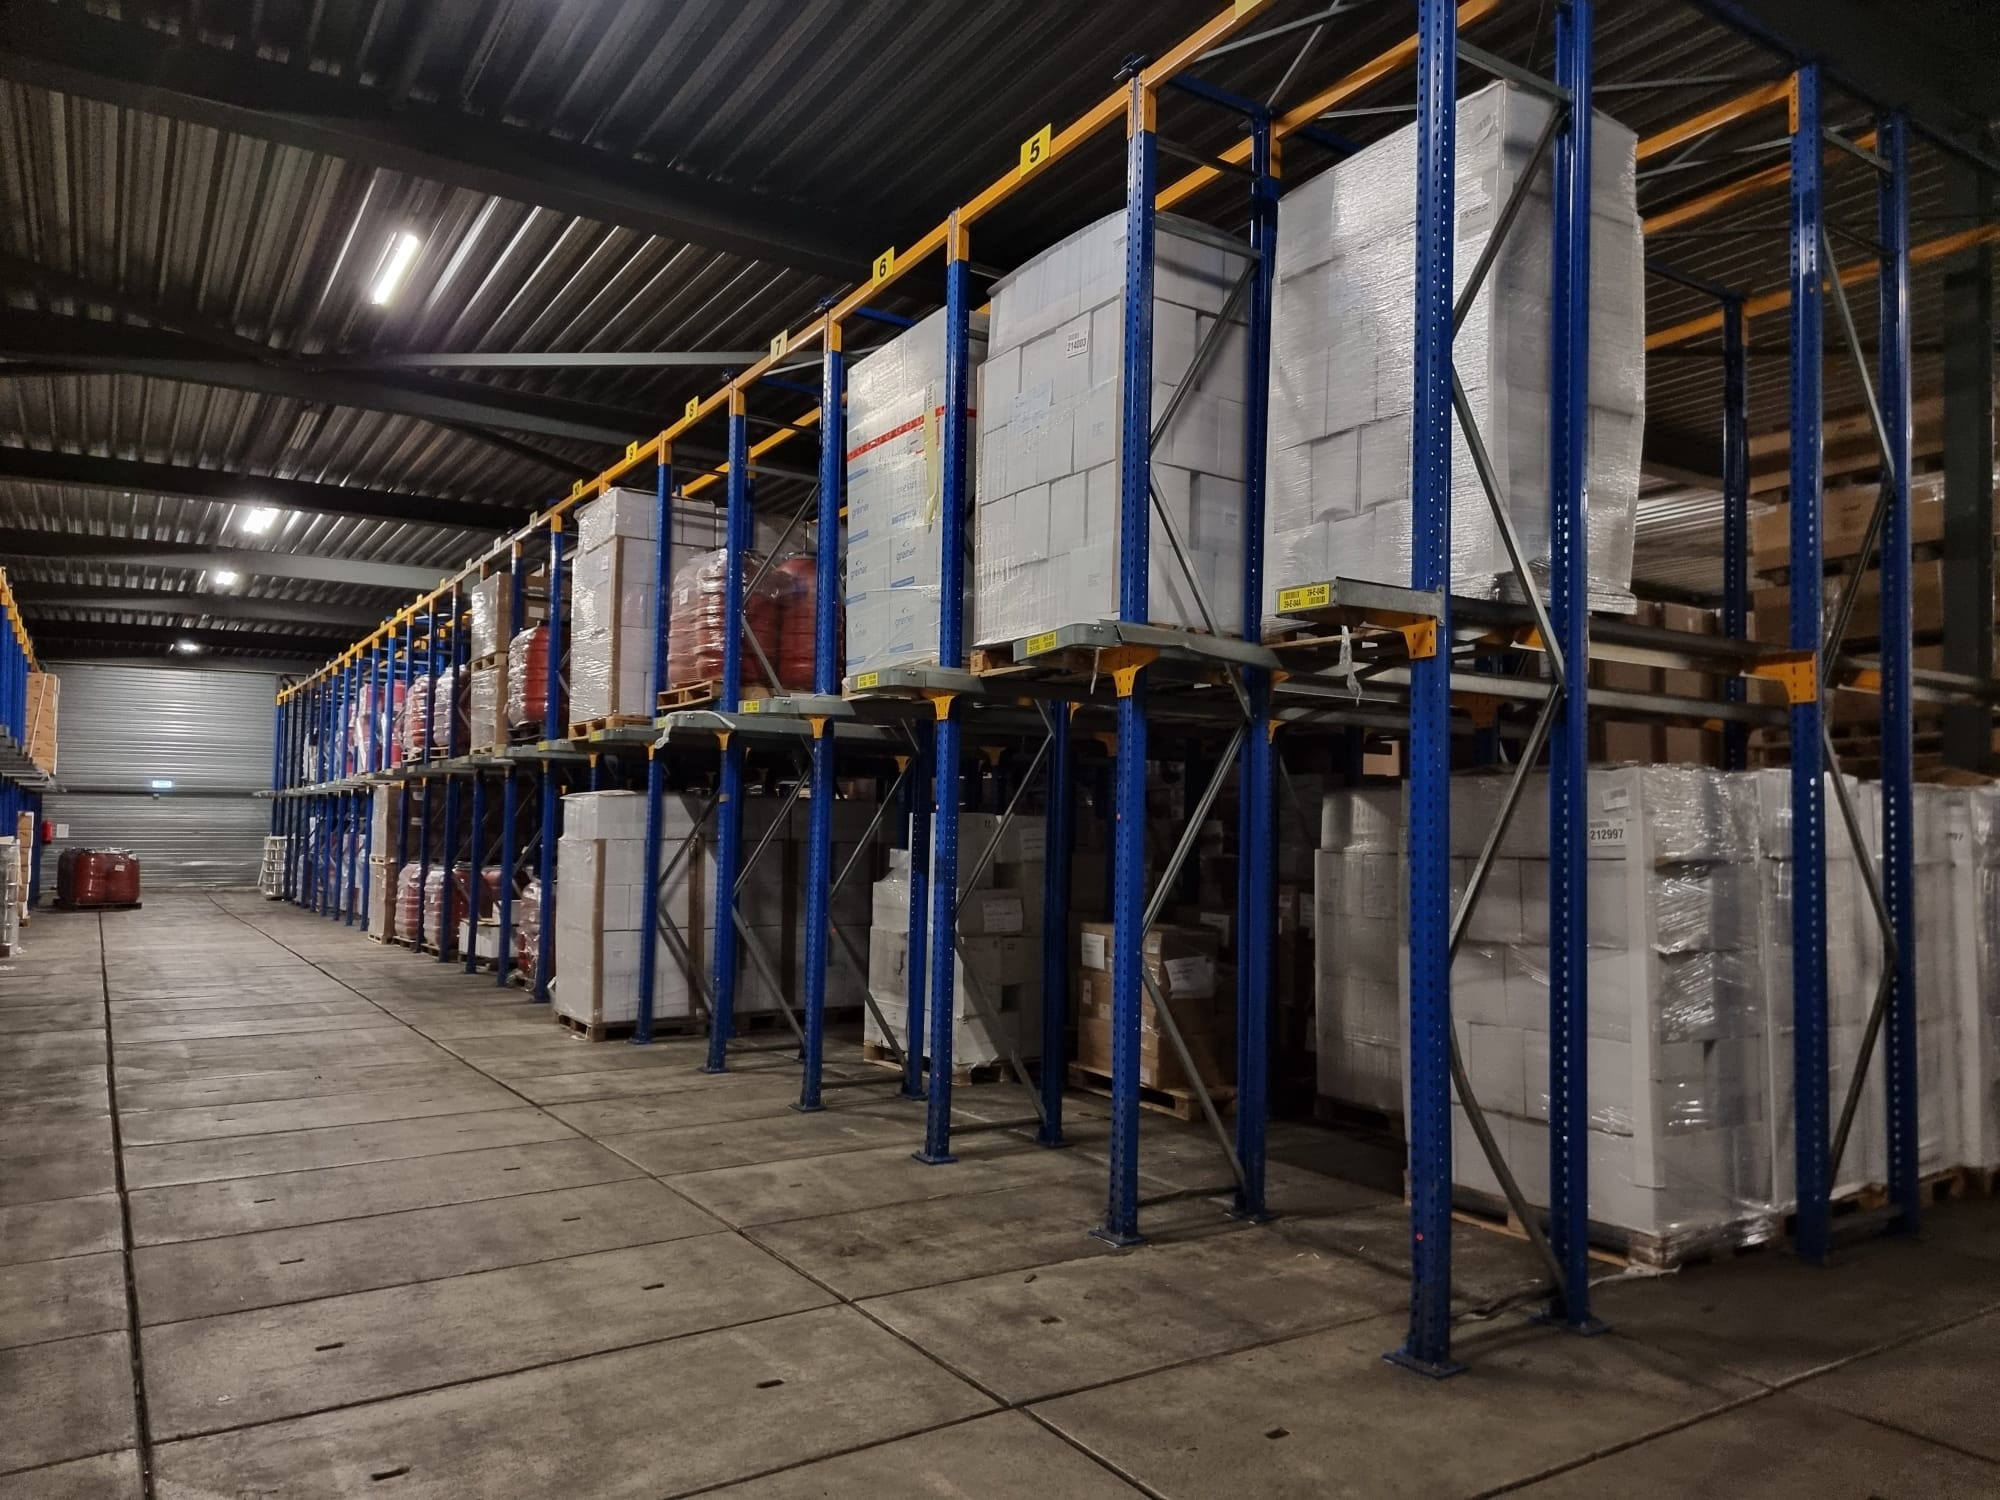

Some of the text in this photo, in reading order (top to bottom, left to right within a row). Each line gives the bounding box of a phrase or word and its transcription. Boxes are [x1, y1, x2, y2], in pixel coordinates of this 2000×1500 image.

[1029, 137, 1041, 164] 5
[879, 257, 888, 279] 6
[775, 338, 782, 356] 7
[1590, 828, 1624, 840] 212997
